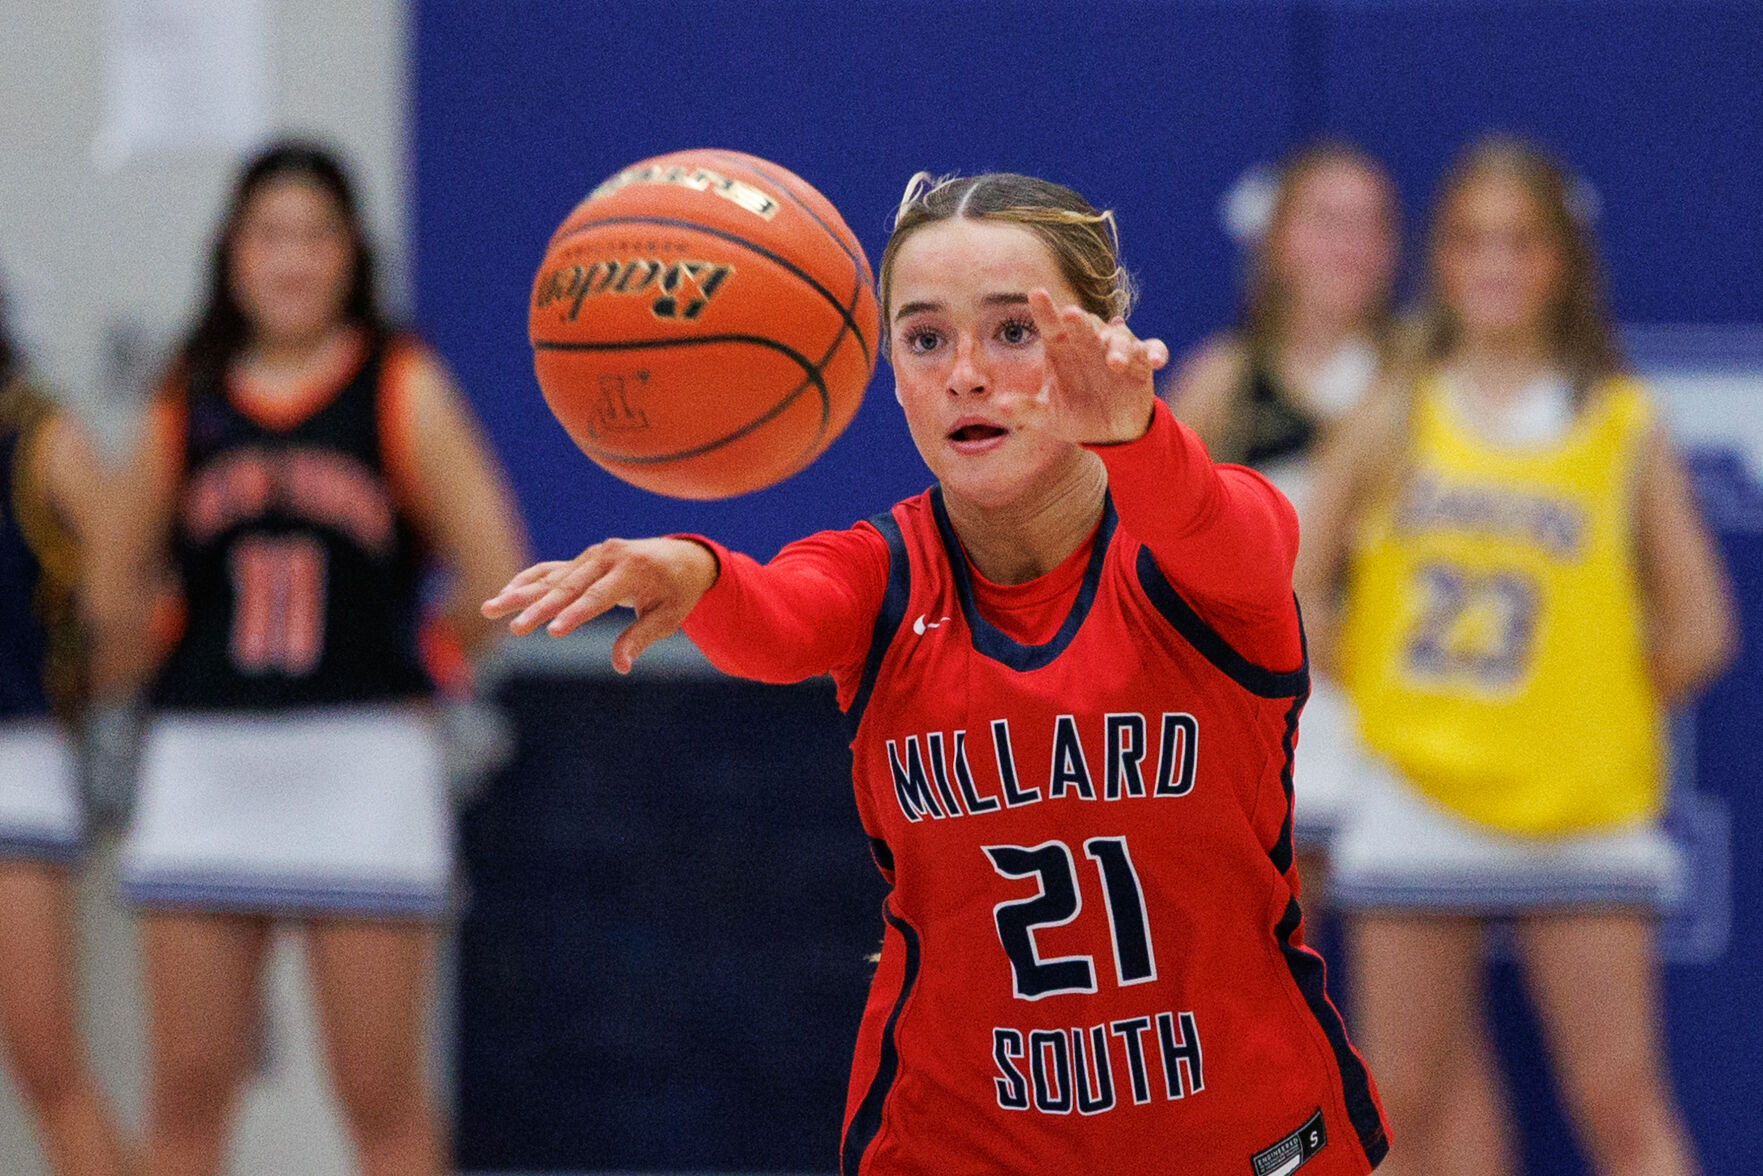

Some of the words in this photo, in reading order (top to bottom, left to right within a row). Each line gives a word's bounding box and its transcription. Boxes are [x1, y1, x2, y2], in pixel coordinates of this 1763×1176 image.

[886, 712, 1200, 823] MILLARD
[981, 835, 1158, 1002] 21
[992, 1011, 1205, 1116] SOUTH
[1257, 1137, 1299, 1166] ENGINEERED
[1309, 1130, 1319, 1148] S
